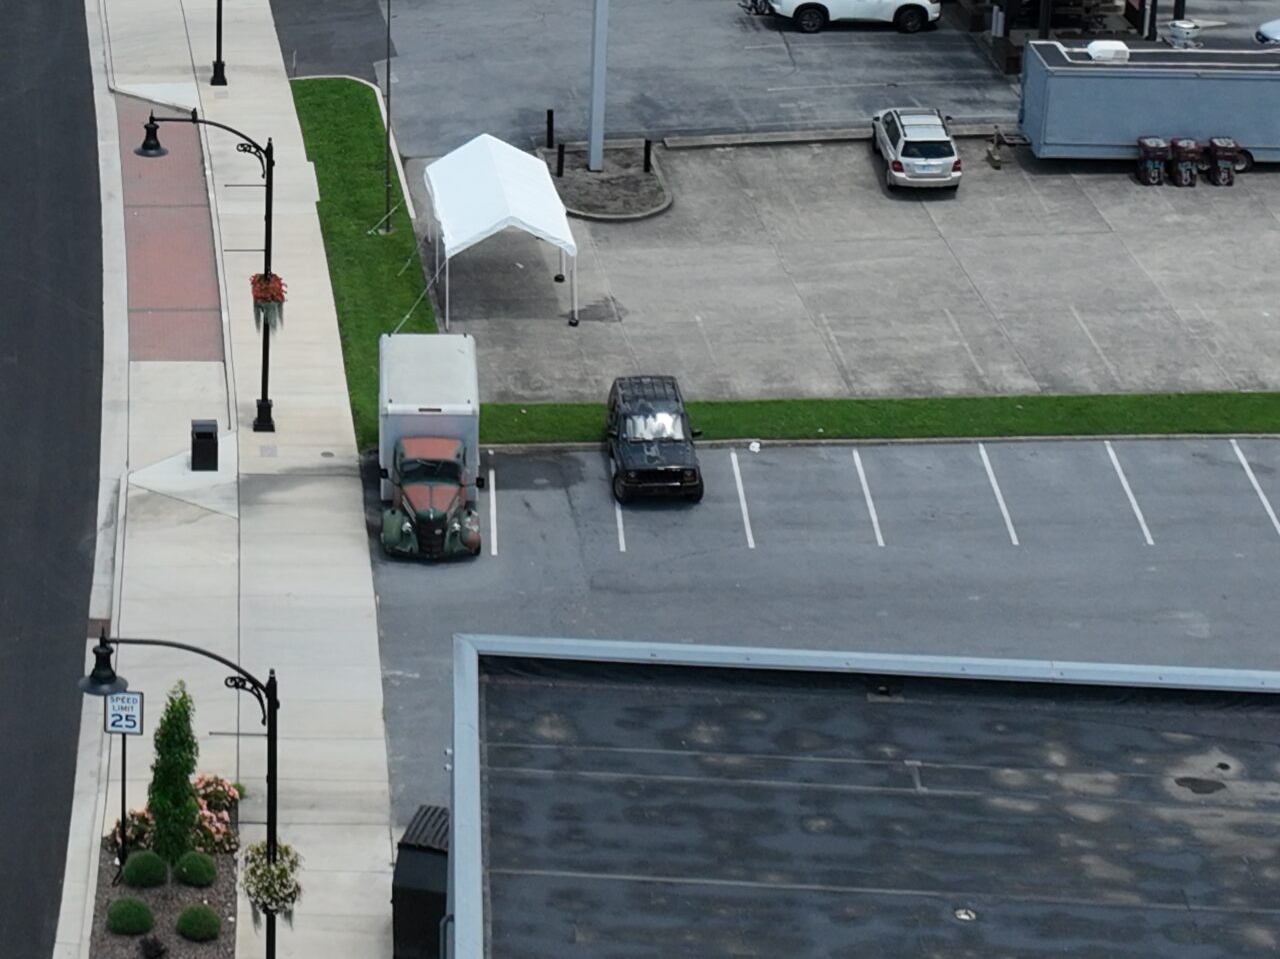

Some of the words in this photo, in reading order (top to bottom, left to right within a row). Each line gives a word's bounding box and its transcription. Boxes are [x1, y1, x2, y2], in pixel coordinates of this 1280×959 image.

[110, 695, 138, 704] SPEED
[112, 704, 135, 712] LIMIT
[111, 713, 137, 729] 25
